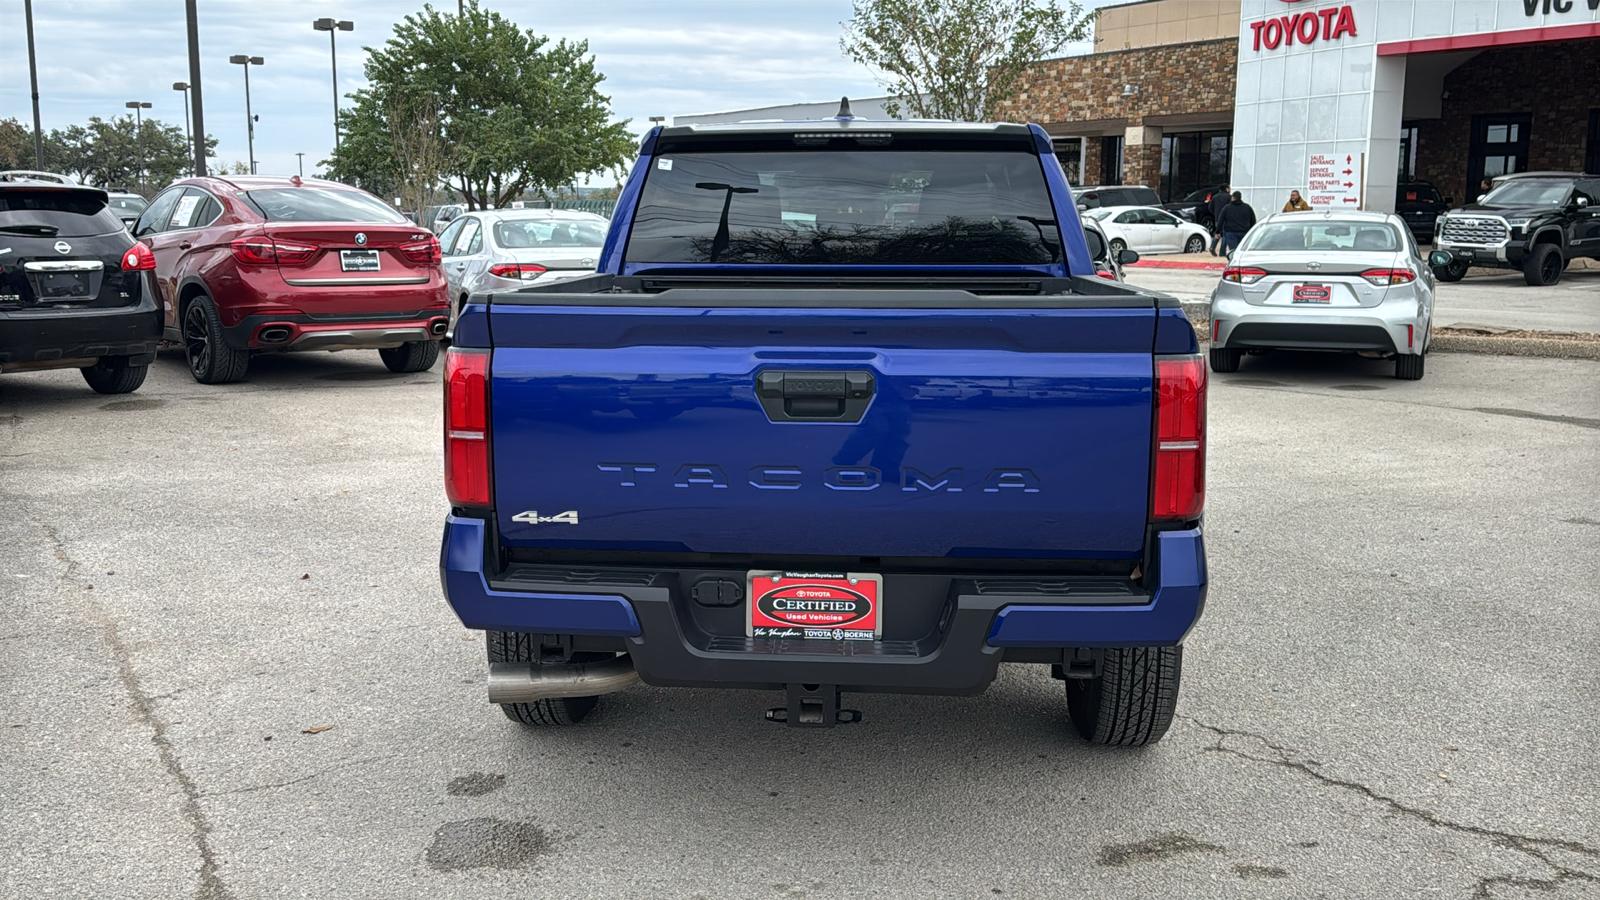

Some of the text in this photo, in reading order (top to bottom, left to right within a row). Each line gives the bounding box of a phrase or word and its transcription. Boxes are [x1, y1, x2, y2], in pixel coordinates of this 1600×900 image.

[1250, 5, 1357, 51] TOYOTA
[787, 380, 843, 390] TOYOTA
[597, 461, 1040, 492] TACOMA
[511, 510, 579, 524] 4x4
[772, 598, 856, 611] CERTIFIED
[768, 628, 802, 638] Vaughan
